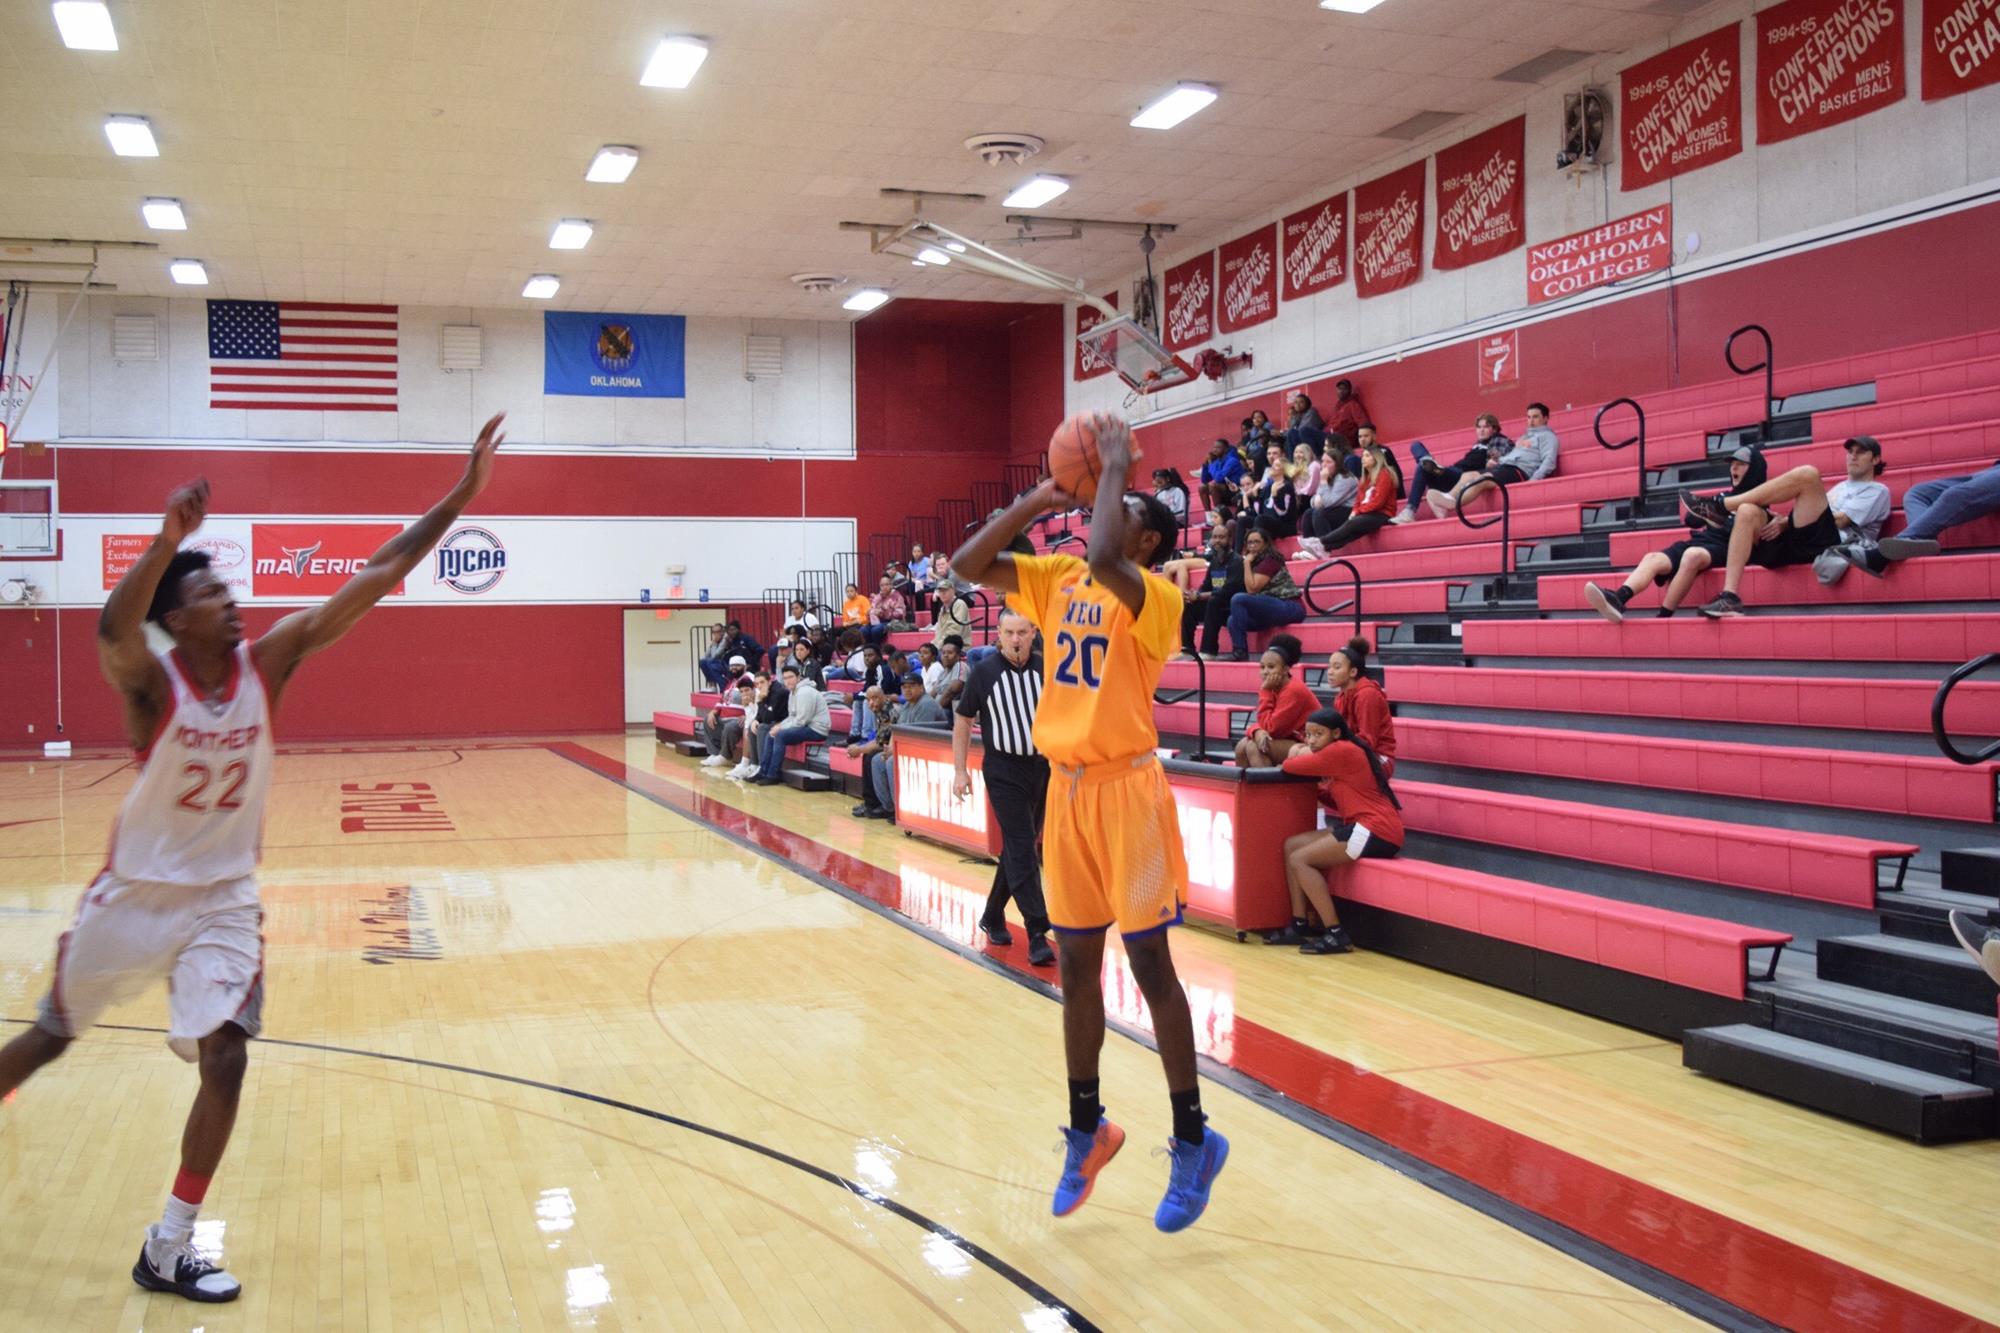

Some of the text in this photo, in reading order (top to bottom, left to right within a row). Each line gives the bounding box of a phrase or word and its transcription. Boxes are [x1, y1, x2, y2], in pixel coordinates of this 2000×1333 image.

[1766, 16, 1817, 45] 1994-95
[1778, 0, 1894, 124] CHAMPIONS
[1949, 5, 2000, 78] CHA
[1629, 48, 1713, 150] CONFERENCE
[1819, 78, 1893, 115] BASKETBALL
[1855, 60, 1891, 86] MEN'S
[1638, 59, 1732, 173] CHAMPIONS
[1440, 150, 1504, 233] CONFERENCE
[1449, 159, 1516, 252] CHAMPIONS
[1285, 204, 1333, 273] CONFERENCE
[1291, 213, 1342, 290] CHAMPIONS
[1355, 190, 1410, 264] CONFERENCE
[1363, 200, 1418, 284] CHAMPIONS
[1530, 230, 1667, 282] OKLAHOMA
[1531, 209, 1664, 264] NORTHERN
[1543, 254, 1650, 297] COLLEGE
[590, 375, 642, 388] OKLAHOMA
[438, 549, 506, 579] NJCAA
[1055, 631, 1109, 689] 20
[176, 760, 249, 812] 22
